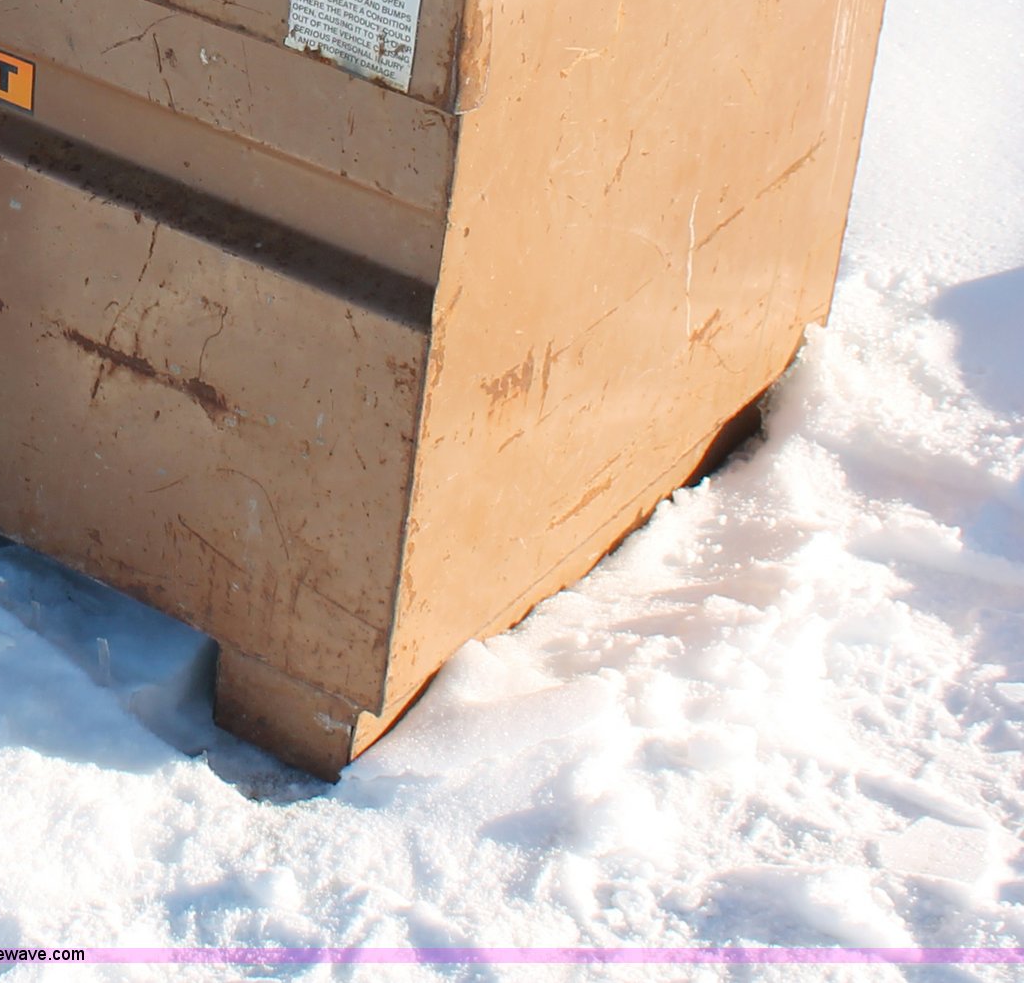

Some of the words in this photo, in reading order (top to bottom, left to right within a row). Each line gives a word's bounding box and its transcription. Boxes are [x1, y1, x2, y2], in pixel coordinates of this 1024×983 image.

[291, 12, 309, 25] OUT
[309, 19, 322, 29] OF
[323, 23, 339, 36] THE
[339, 28, 372, 49] VEHICLE
[292, 2, 317, 18] OPEN,
[318, 11, 354, 32] CAUSING
[354, 26, 363, 36] IT
[363, 29, 375, 40] TO
[326, 4, 343, 17] THE
[343, 10, 380, 32] PRODUCT
[382, 27, 411, 44] COULD
[359, 7, 366, 16] A
[366, 9, 413, 33] CONDITION
[381, 5, 412, 23] BUMPS
[293, 24, 331, 42] SERIOUS
[331, 37, 373, 61] PERSONAL
